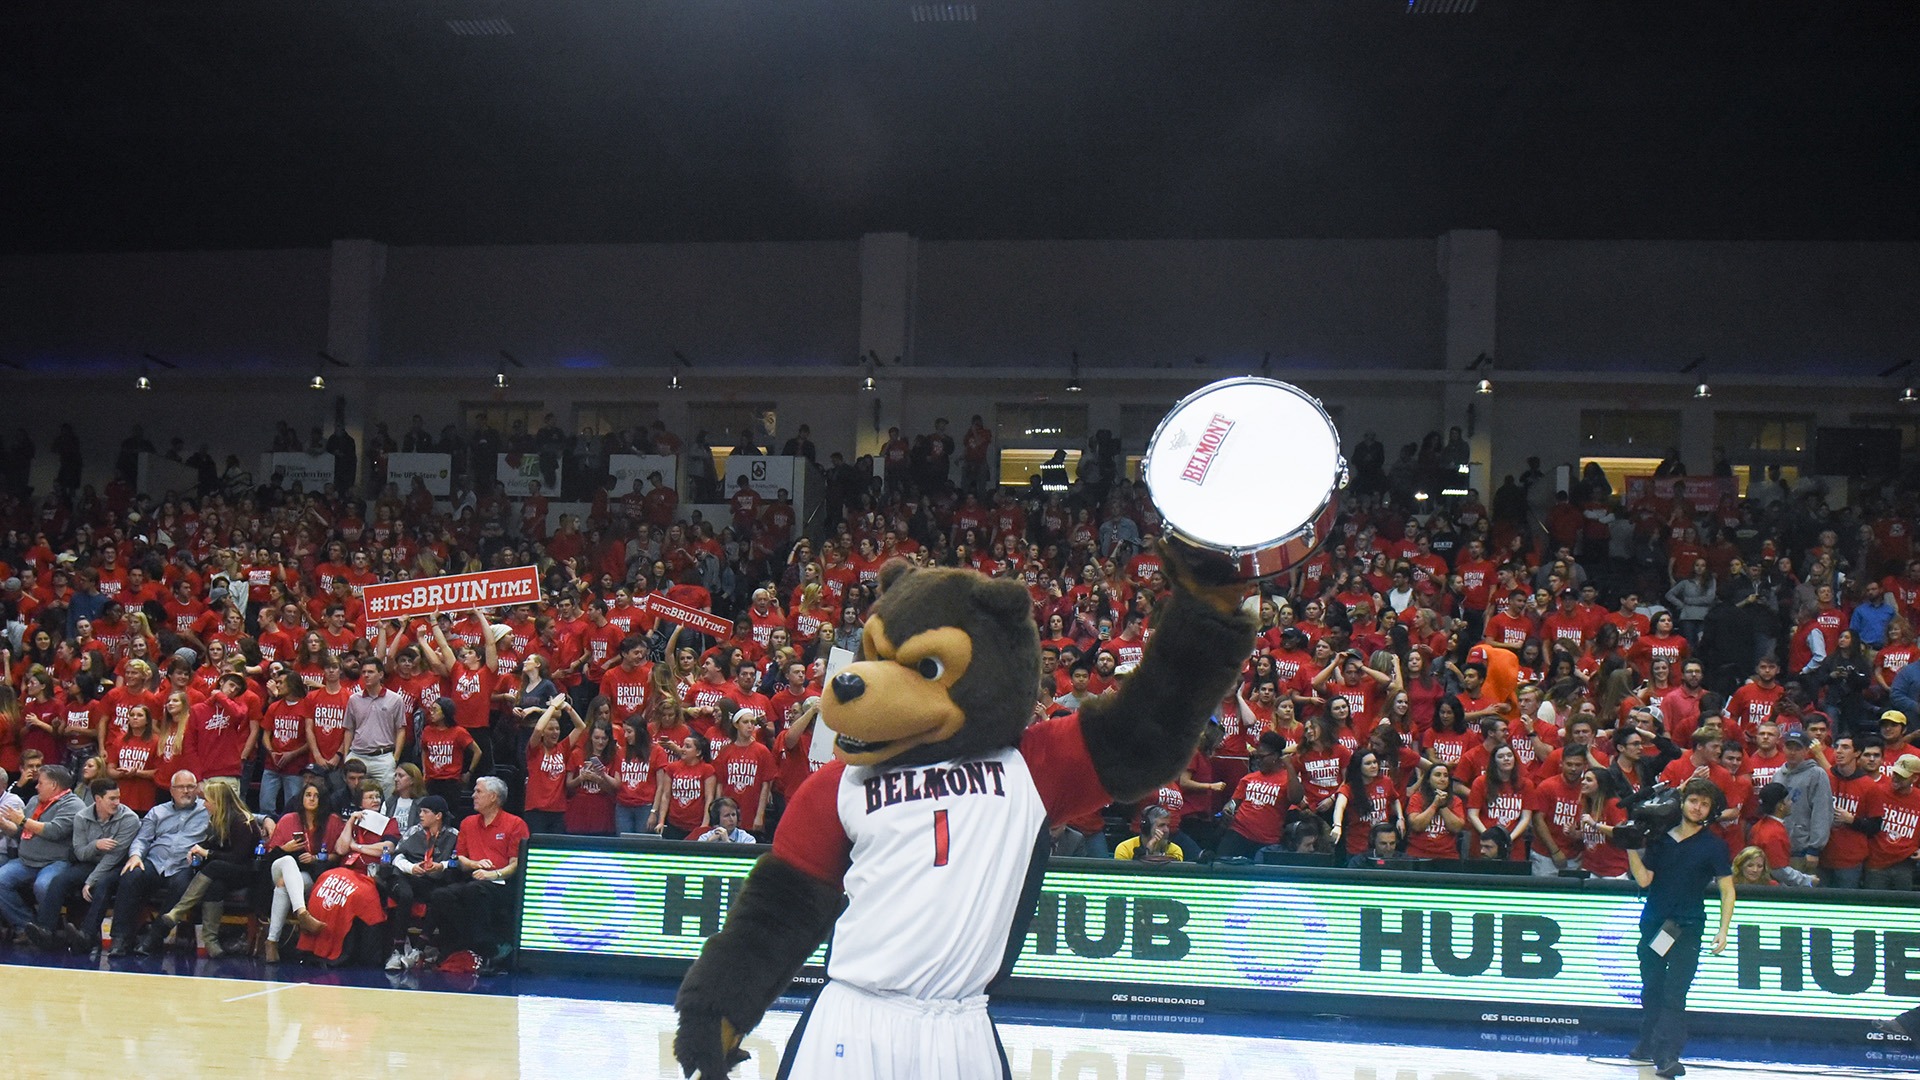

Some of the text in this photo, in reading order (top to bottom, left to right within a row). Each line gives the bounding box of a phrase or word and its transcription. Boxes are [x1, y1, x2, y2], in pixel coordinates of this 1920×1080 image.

[1182, 414, 1232, 483] BELMONT
[1138, 563, 1158, 571] BRUIN
[1505, 629, 1526, 640] BRUIN
[1557, 629, 1581, 639] BRUIN
[1652, 648, 1679, 657] BRUIN
[618, 687, 645, 697] BRUIN
[617, 696, 644, 706] NATION
[315, 707, 344, 719] BRUIN
[1750, 704, 1771, 716] BRU
[274, 719, 299, 730] BRUIN
[315, 718, 343, 729] NATION
[428, 745, 454, 755] BRUIN
[1433, 743, 1462, 756] BRUIN
[1512, 739, 1532, 750] BRU
[119, 748, 149, 761] BRUIN
[621, 762, 650, 773] BRUIN
[728, 763, 758, 776] BRUIN
[672, 778, 701, 790] BRUIN
[863, 761, 1005, 815] BELMONT
[1246, 782, 1281, 797] BRUIN
[1245, 792, 1278, 807] NATION
[1488, 797, 1522, 810] BRUIN
[1832, 795, 1859, 813] RUIN
[1488, 808, 1521, 820] NATION
[1556, 801, 1577, 816] BRU
[1881, 808, 1919, 828] BRUIN
[323, 876, 356, 897] BRUIN
[317, 887, 348, 907] NATION
[1360, 907, 1562, 979] HUB
[1131, 996, 1206, 1006] SCOREBOARDS
[1501, 1015, 1579, 1025] SCOREBOARDS
